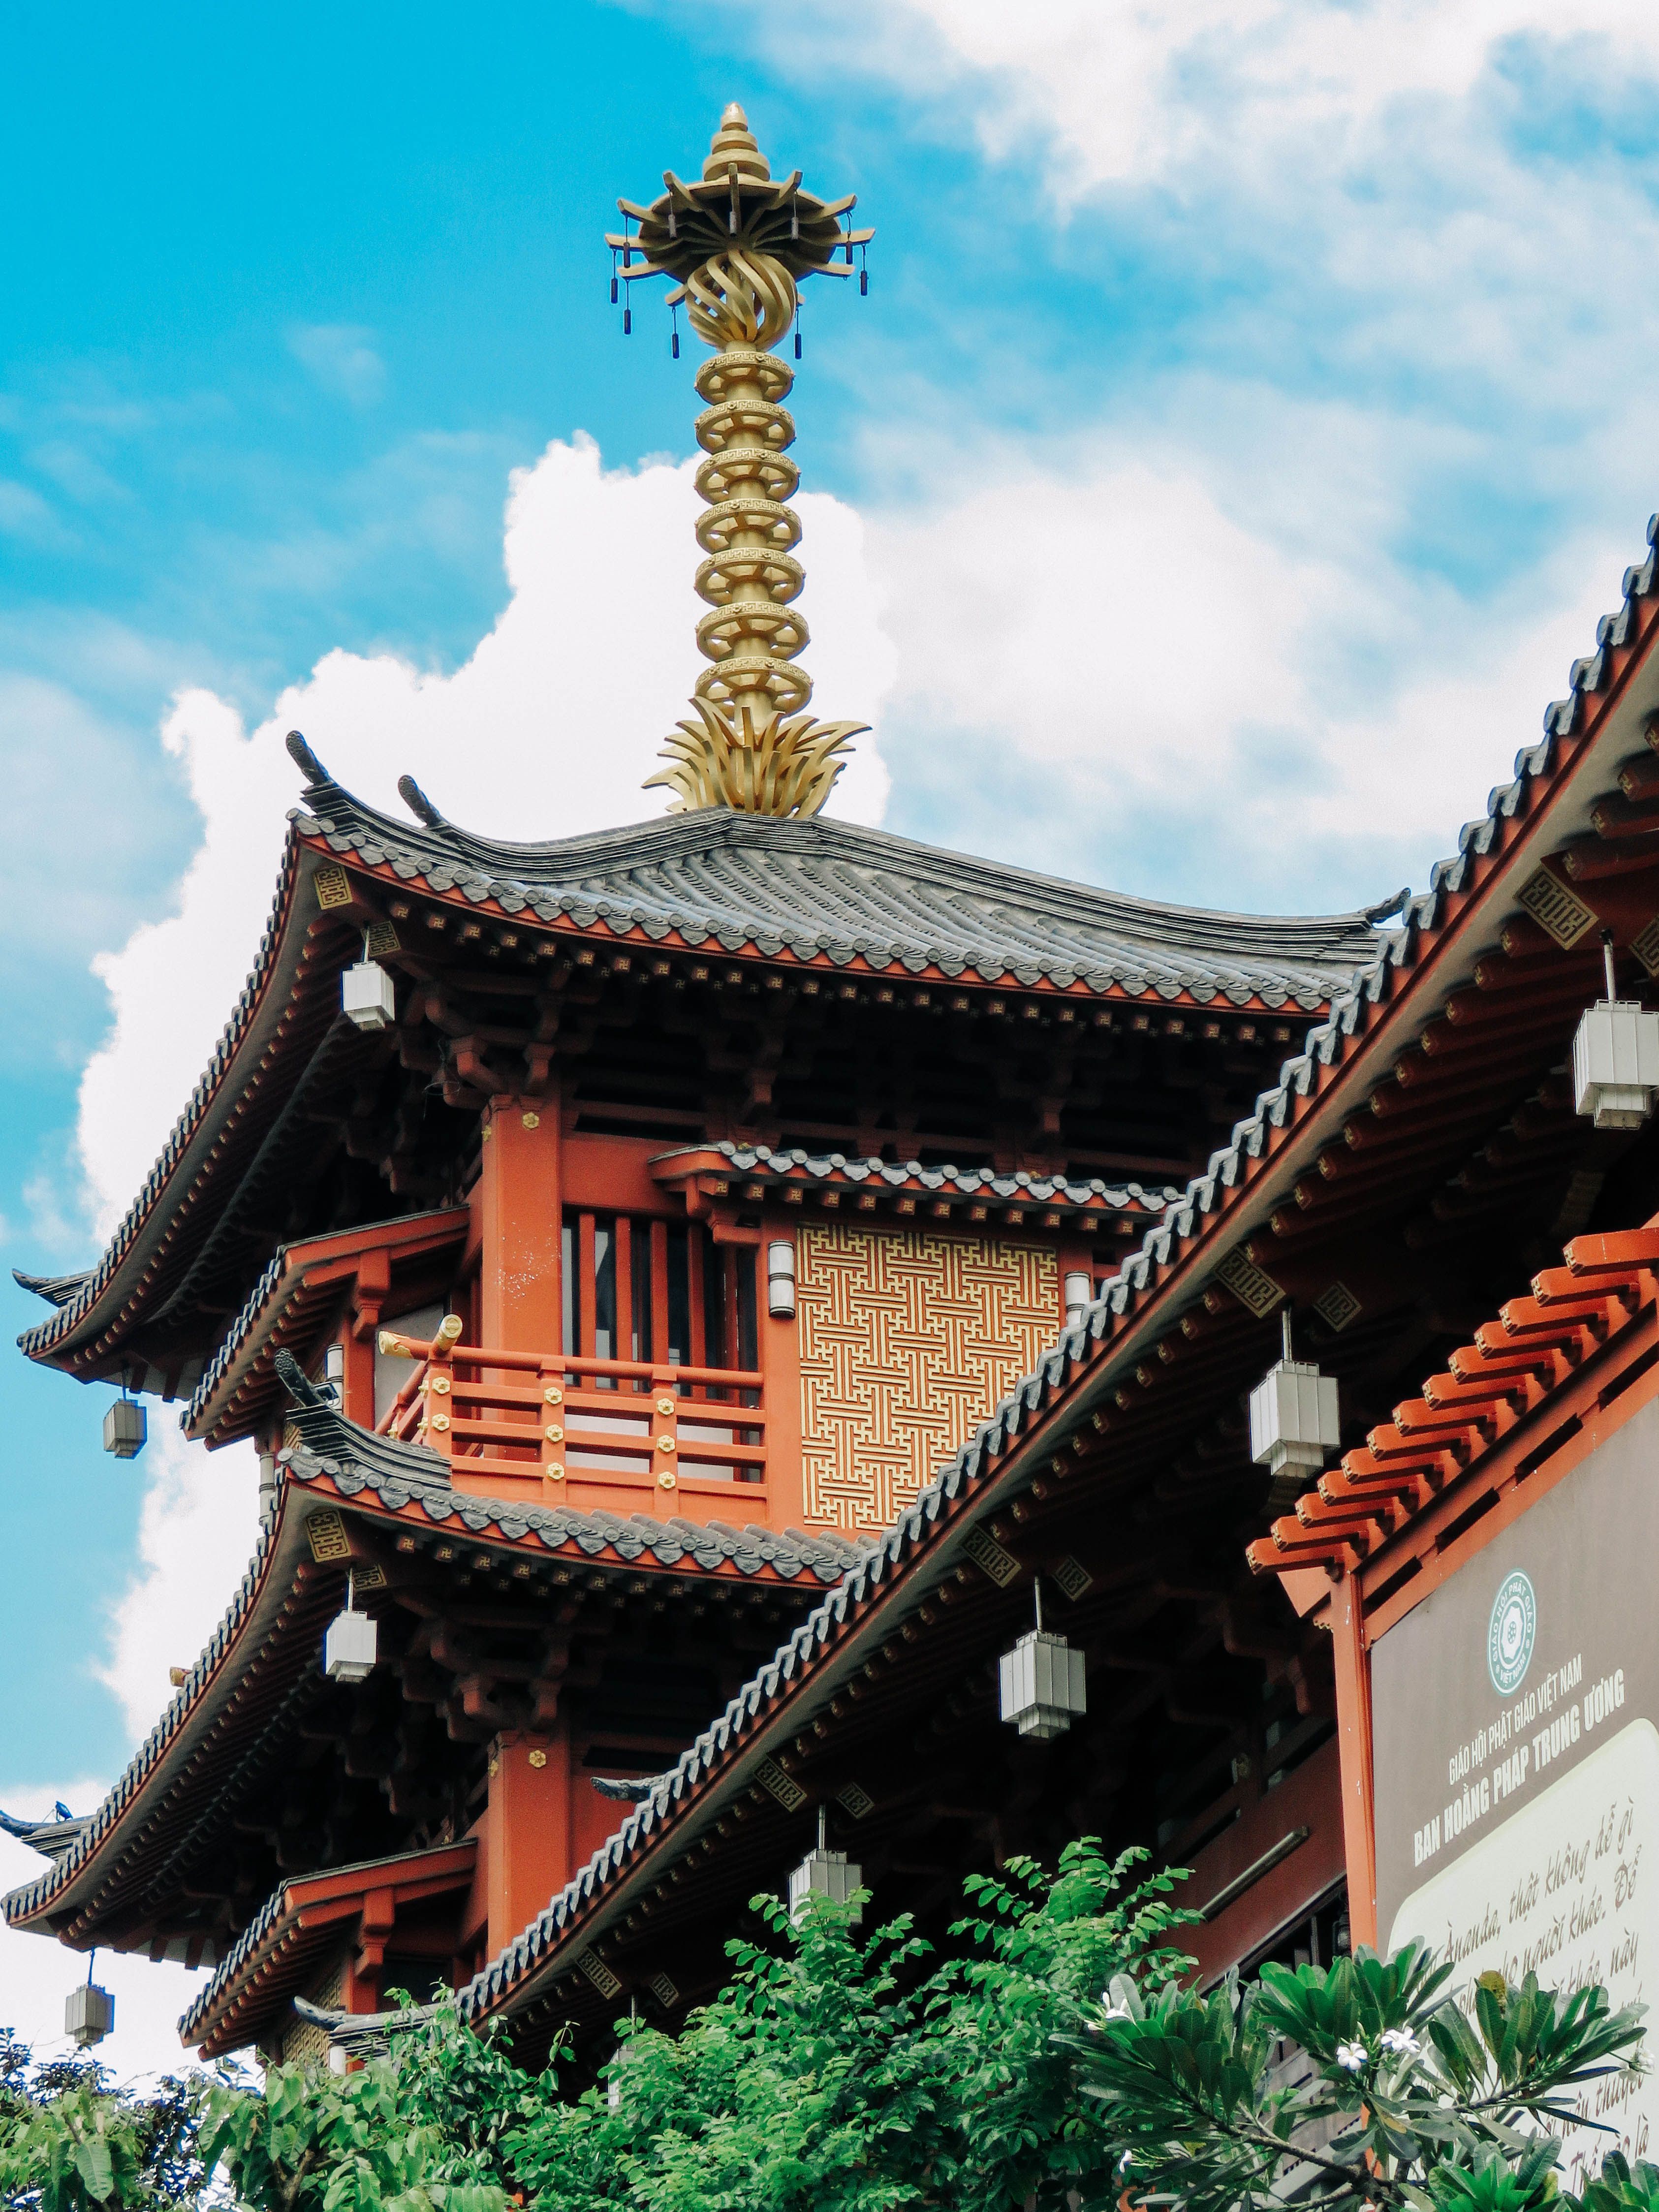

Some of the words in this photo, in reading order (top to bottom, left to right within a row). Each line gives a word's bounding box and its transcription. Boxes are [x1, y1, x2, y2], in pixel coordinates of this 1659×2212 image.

[1449, 1745, 1470, 1786] GIÁO
[1471, 1729, 1487, 1768] HỘI
[1489, 1710, 1512, 1754] PHẬT
[1514, 1691, 1536, 1733] GIÁO
[1537, 1673, 1558, 1714] VIỆT
[1560, 1653, 1582, 1696] NAM
[1512, 1652, 1527, 1681] NAM
[1413, 1814, 1441, 1868] BAN
[1444, 1777, 1490, 1844] HOẰNG
[1493, 1746, 1529, 1805] PHÁP
[1532, 1704, 1581, 1772] TRUNG
[1583, 1668, 1625, 1732] ƯƠNG
[1509, 1871, 1539, 1924] thật
[1544, 1839, 1591, 1898] không
[1595, 1801, 1617, 1860] dễ
[1618, 1795, 1634, 1855] gì
[1610, 1927, 1639, 1977] này
